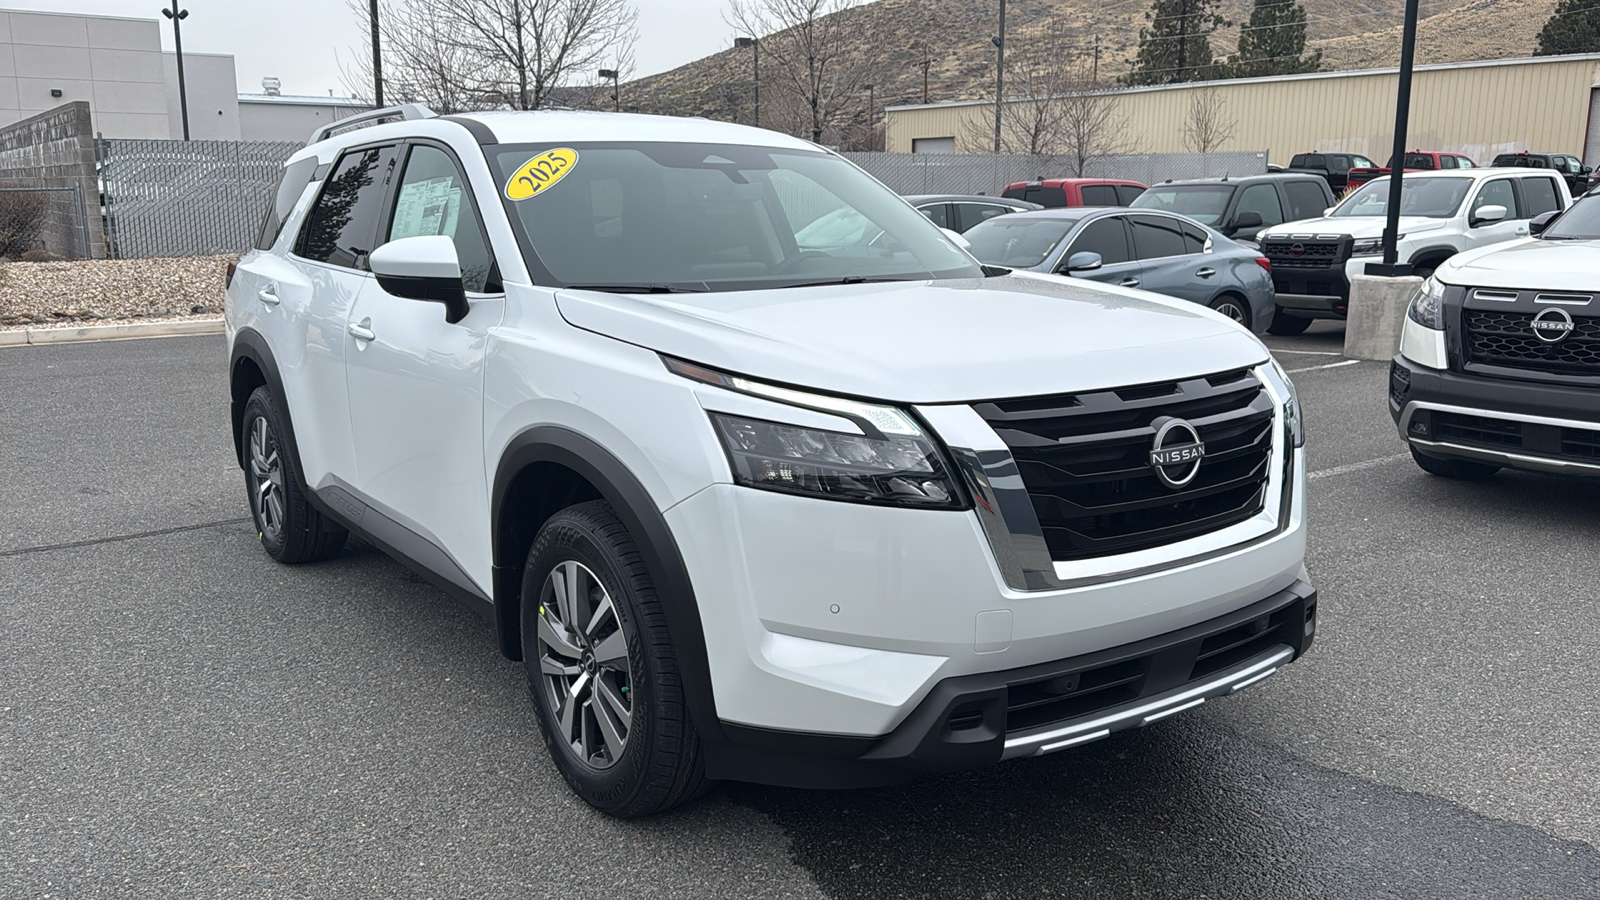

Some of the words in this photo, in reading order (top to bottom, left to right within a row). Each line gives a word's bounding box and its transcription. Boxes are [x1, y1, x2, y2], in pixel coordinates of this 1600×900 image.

[518, 152, 567, 192] 2025
[1531, 321, 1573, 330] NISSAN
[1152, 445, 1205, 463] NISSAN
[591, 775, 628, 801] KUMHO
